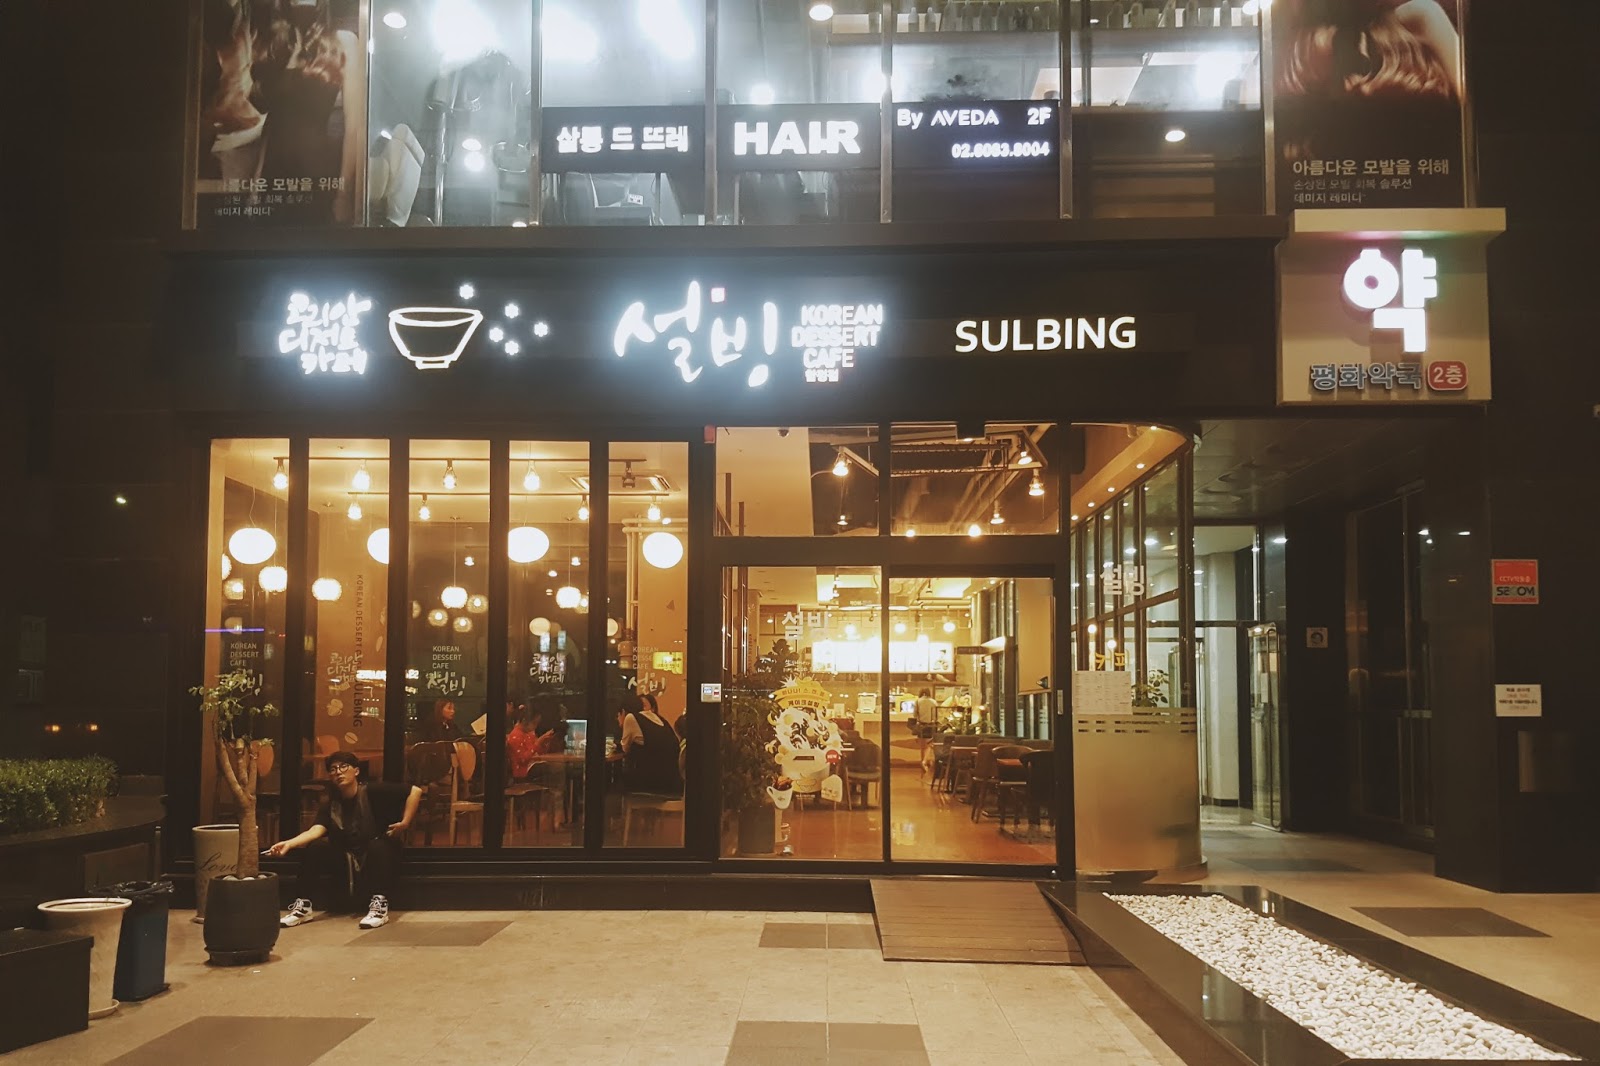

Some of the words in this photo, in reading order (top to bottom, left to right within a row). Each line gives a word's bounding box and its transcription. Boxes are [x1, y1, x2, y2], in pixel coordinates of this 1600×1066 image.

[897, 109, 921, 130] By
[930, 110, 999, 126] AVEDA
[1027, 107, 1051, 125] 2F
[611, 128, 633, 149] 드
[642, 126, 687, 151] 뜨레
[734, 120, 861, 155] HAIR
[1293, 160, 1357, 175] 아름다운
[1363, 159, 1412, 175] 모발을
[1418, 159, 1449, 175] 위해
[223, 178, 268, 192] 름다운
[272, 177, 313, 192] 모발을
[318, 177, 345, 191] 위해
[1380, 178, 1412, 189] 솔루션
[1343, 249, 1437, 352] 약
[801, 304, 883, 325] KOREAN
[791, 325, 880, 347] DESSERT
[955, 316, 1136, 353] SULBING
[803, 347, 854, 368] CAFE
[1310, 362, 1423, 390] 평화약국
[1433, 366, 1464, 383] 2층
[356, 574, 364, 608] KOREAN
[355, 611, 363, 647] DESSERT
[230, 642, 257, 650] KOREAN
[432, 653, 462, 661] DESSERT
[229, 659, 247, 667] CAFE
[353, 678, 364, 728] ULBING
